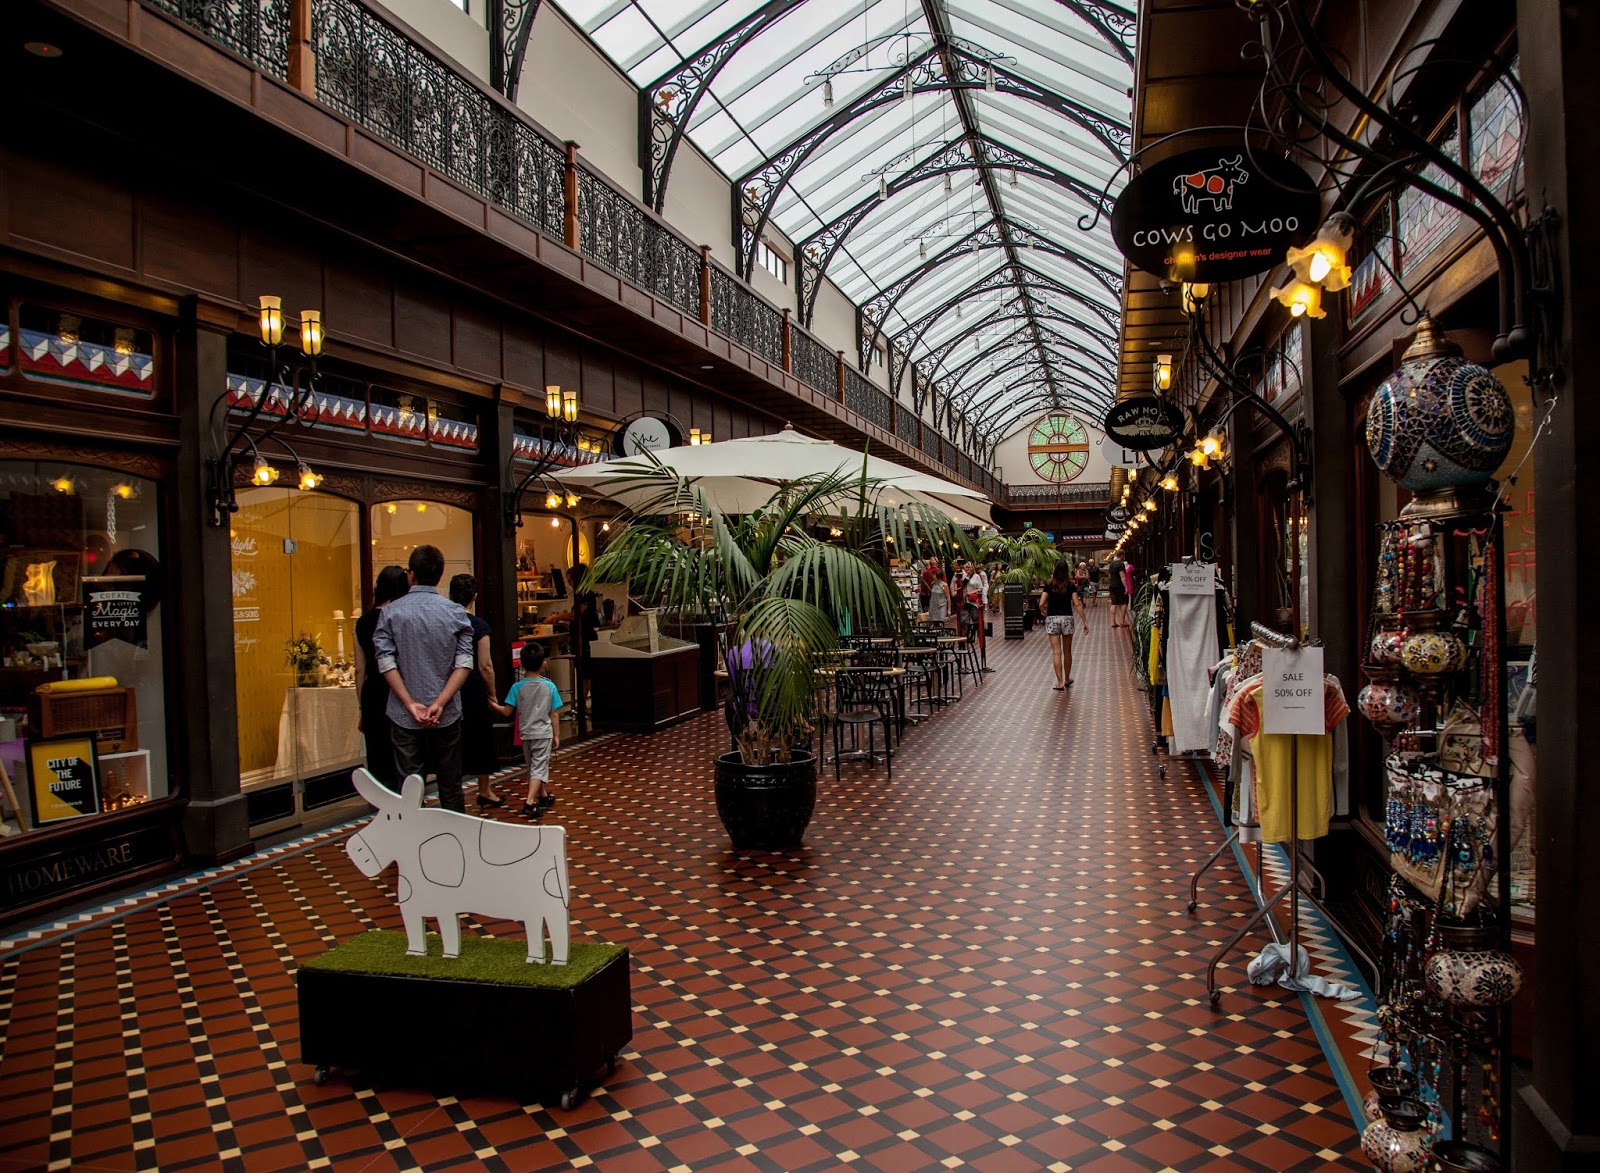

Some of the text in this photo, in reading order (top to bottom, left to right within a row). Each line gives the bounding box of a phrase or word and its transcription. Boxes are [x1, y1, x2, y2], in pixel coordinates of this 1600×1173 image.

[1133, 216, 1299, 247] COWS GO MOO
[1164, 248, 1272, 265] chidren's designer wear
[1117, 407, 1140, 423] RAW
[92, 602, 139, 621] Magic
[1283, 673, 1304, 681] SALE
[1275, 688, 1312, 697] 50% OFF
[47, 756, 79, 769] CITY OF
[55, 769, 73, 779] THE
[49, 779, 82, 792] FUTURE
[8, 842, 133, 897] HOMEWARE
